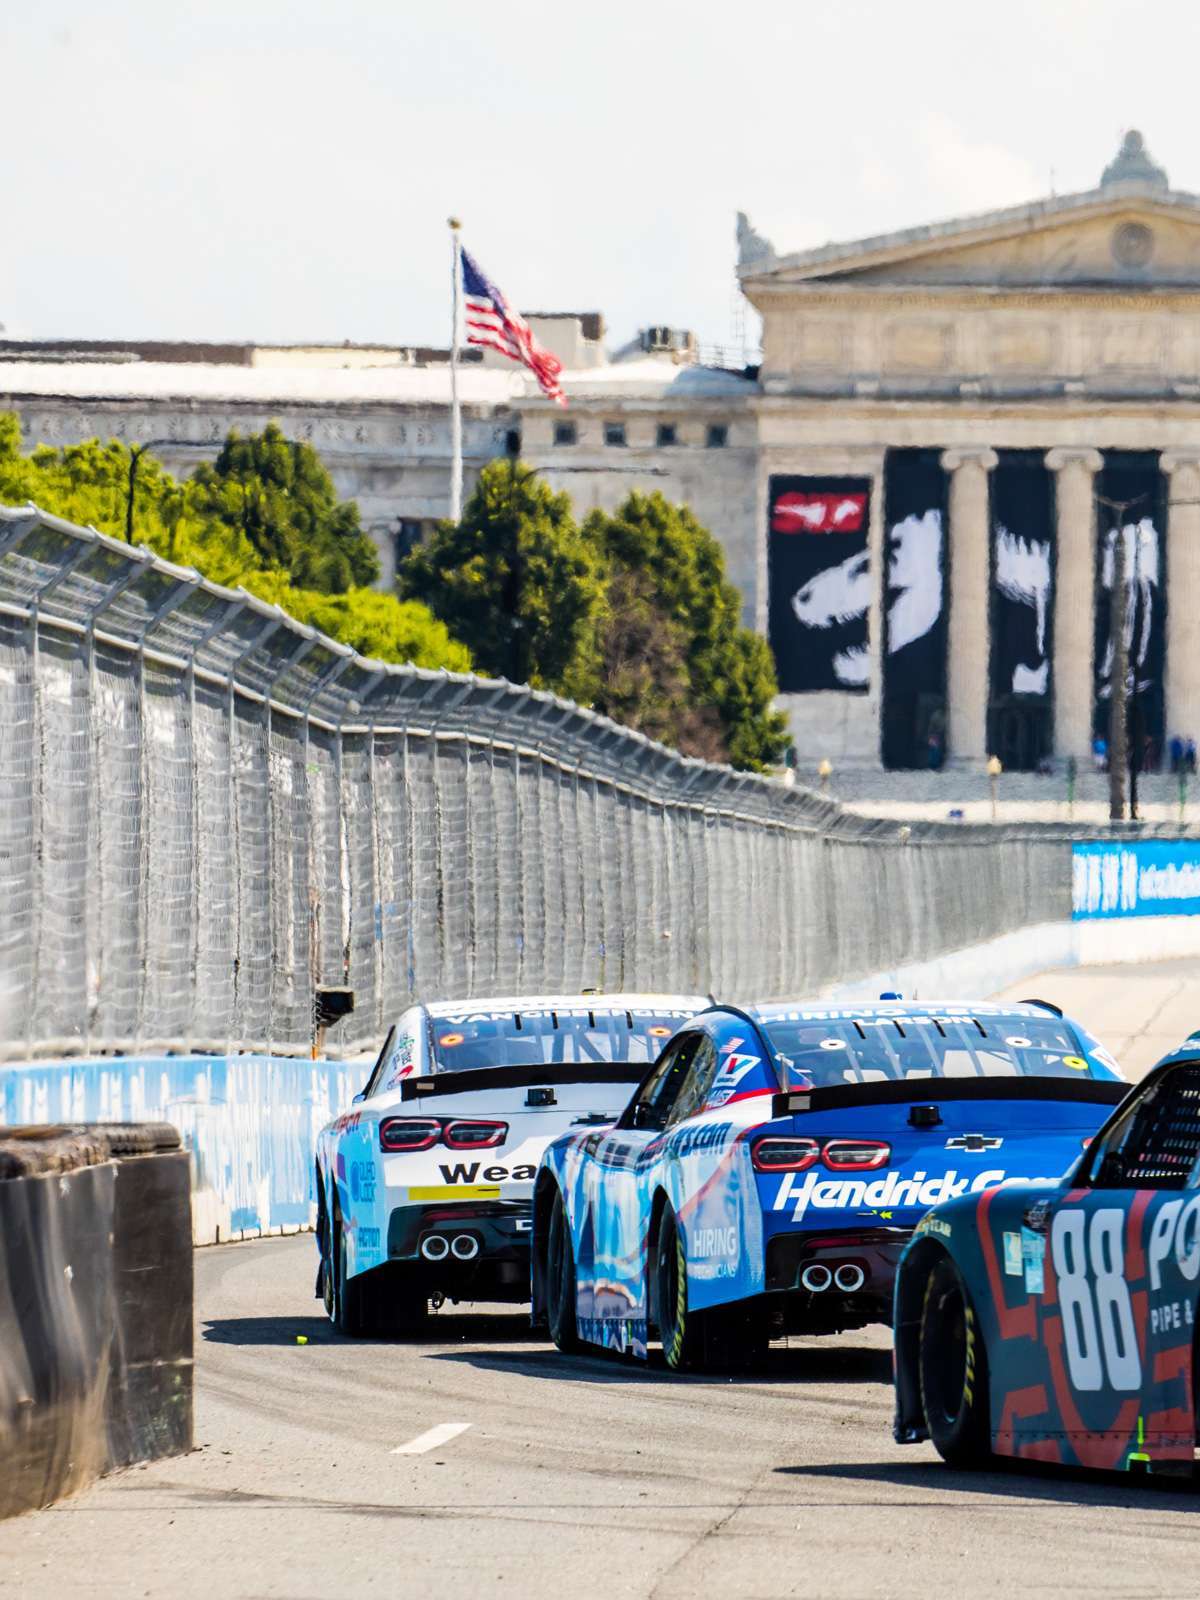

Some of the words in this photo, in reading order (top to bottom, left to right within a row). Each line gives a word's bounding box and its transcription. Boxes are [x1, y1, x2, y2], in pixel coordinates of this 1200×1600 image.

[851, 1015, 983, 1027] LARSON
[694, 1227, 736, 1258] HIRING
[1052, 1208, 1142, 1391] 88
[1151, 1302, 1182, 1334] PIPE
